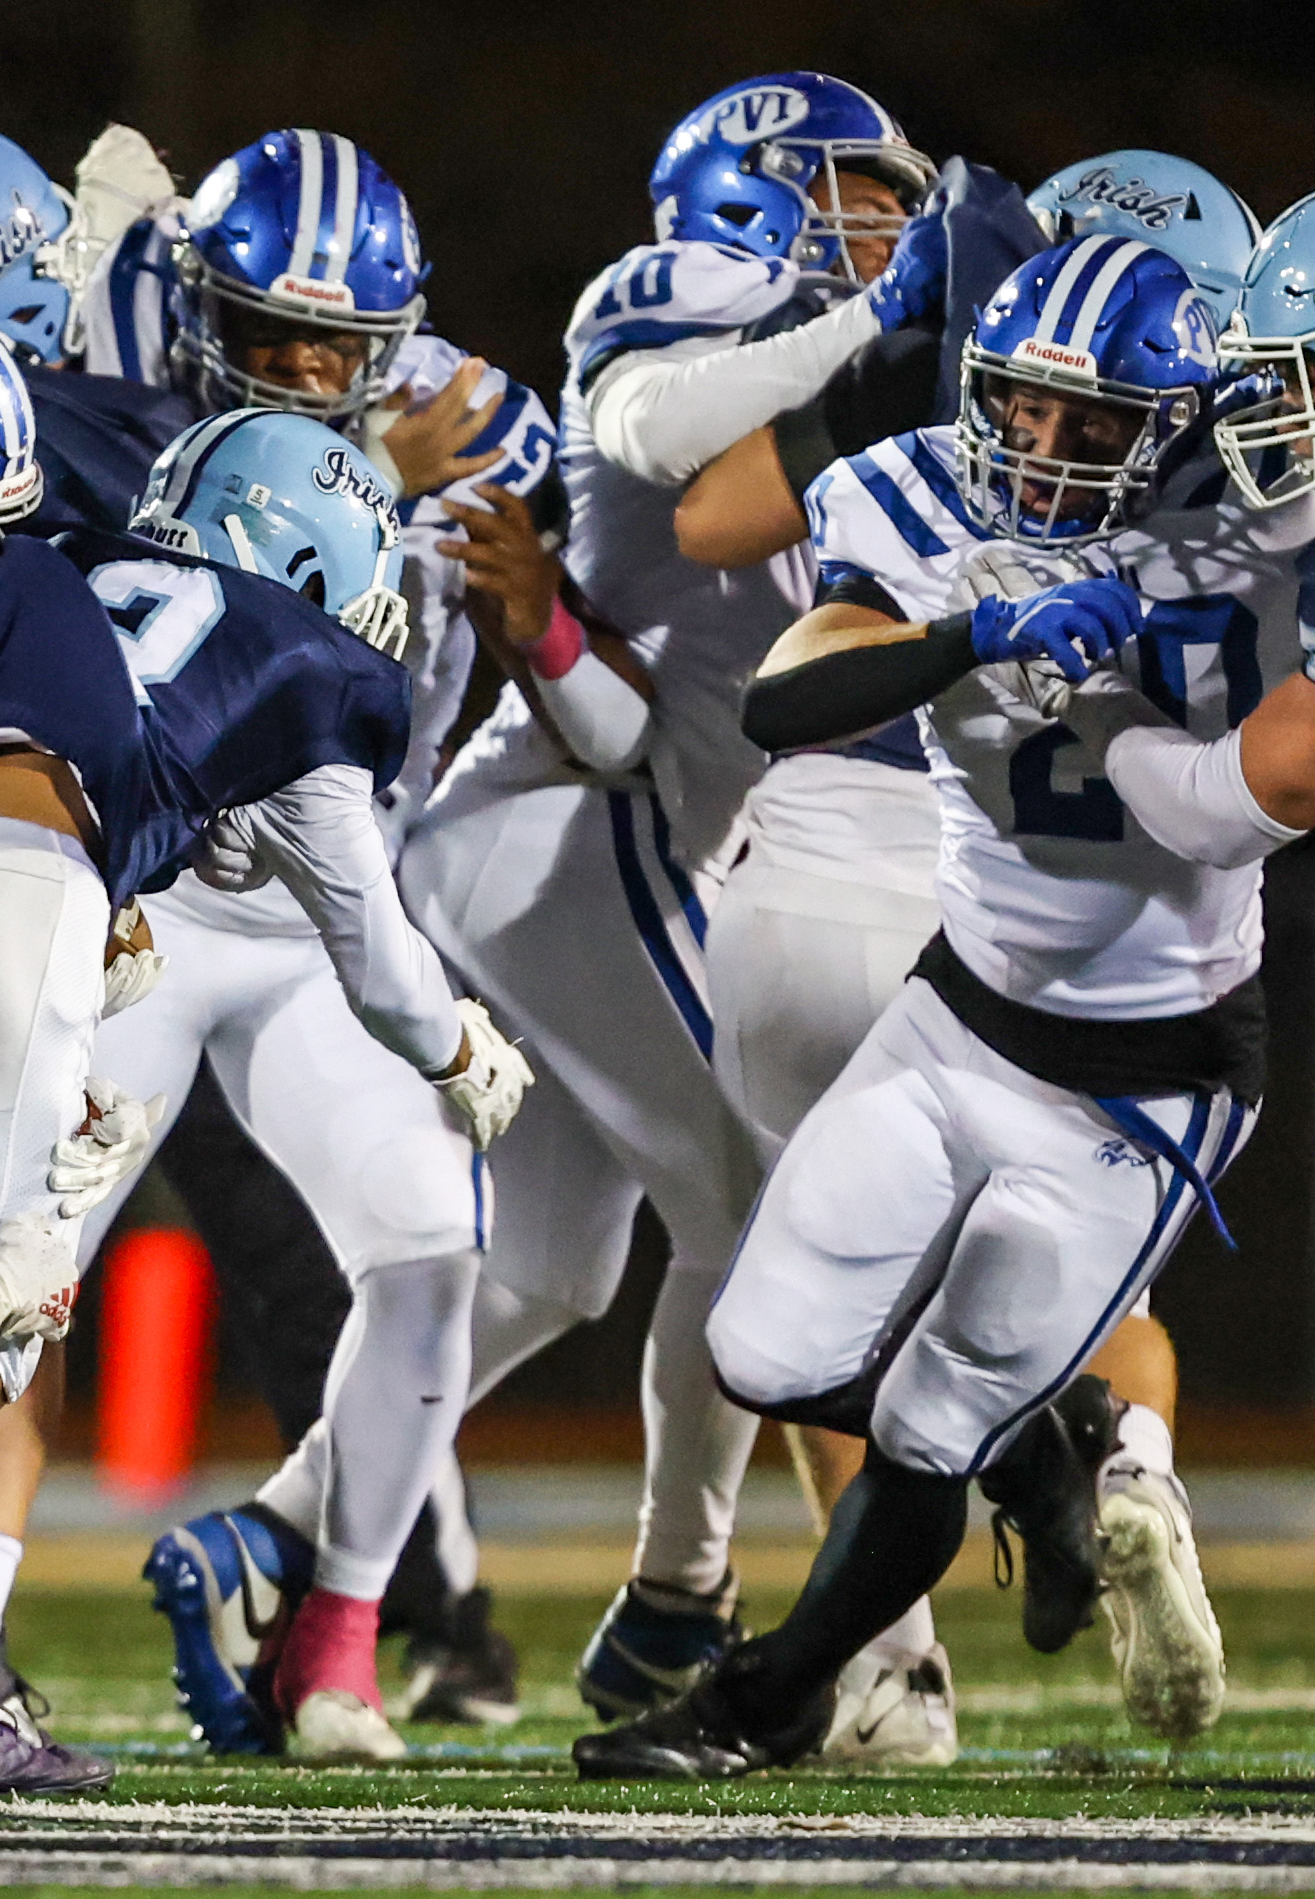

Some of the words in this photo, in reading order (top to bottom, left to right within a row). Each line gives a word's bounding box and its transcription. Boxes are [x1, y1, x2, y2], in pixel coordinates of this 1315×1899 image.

[709, 92, 793, 137] PVI
[1058, 163, 1188, 231] Irish
[1026, 342, 1088, 369] Riddell
